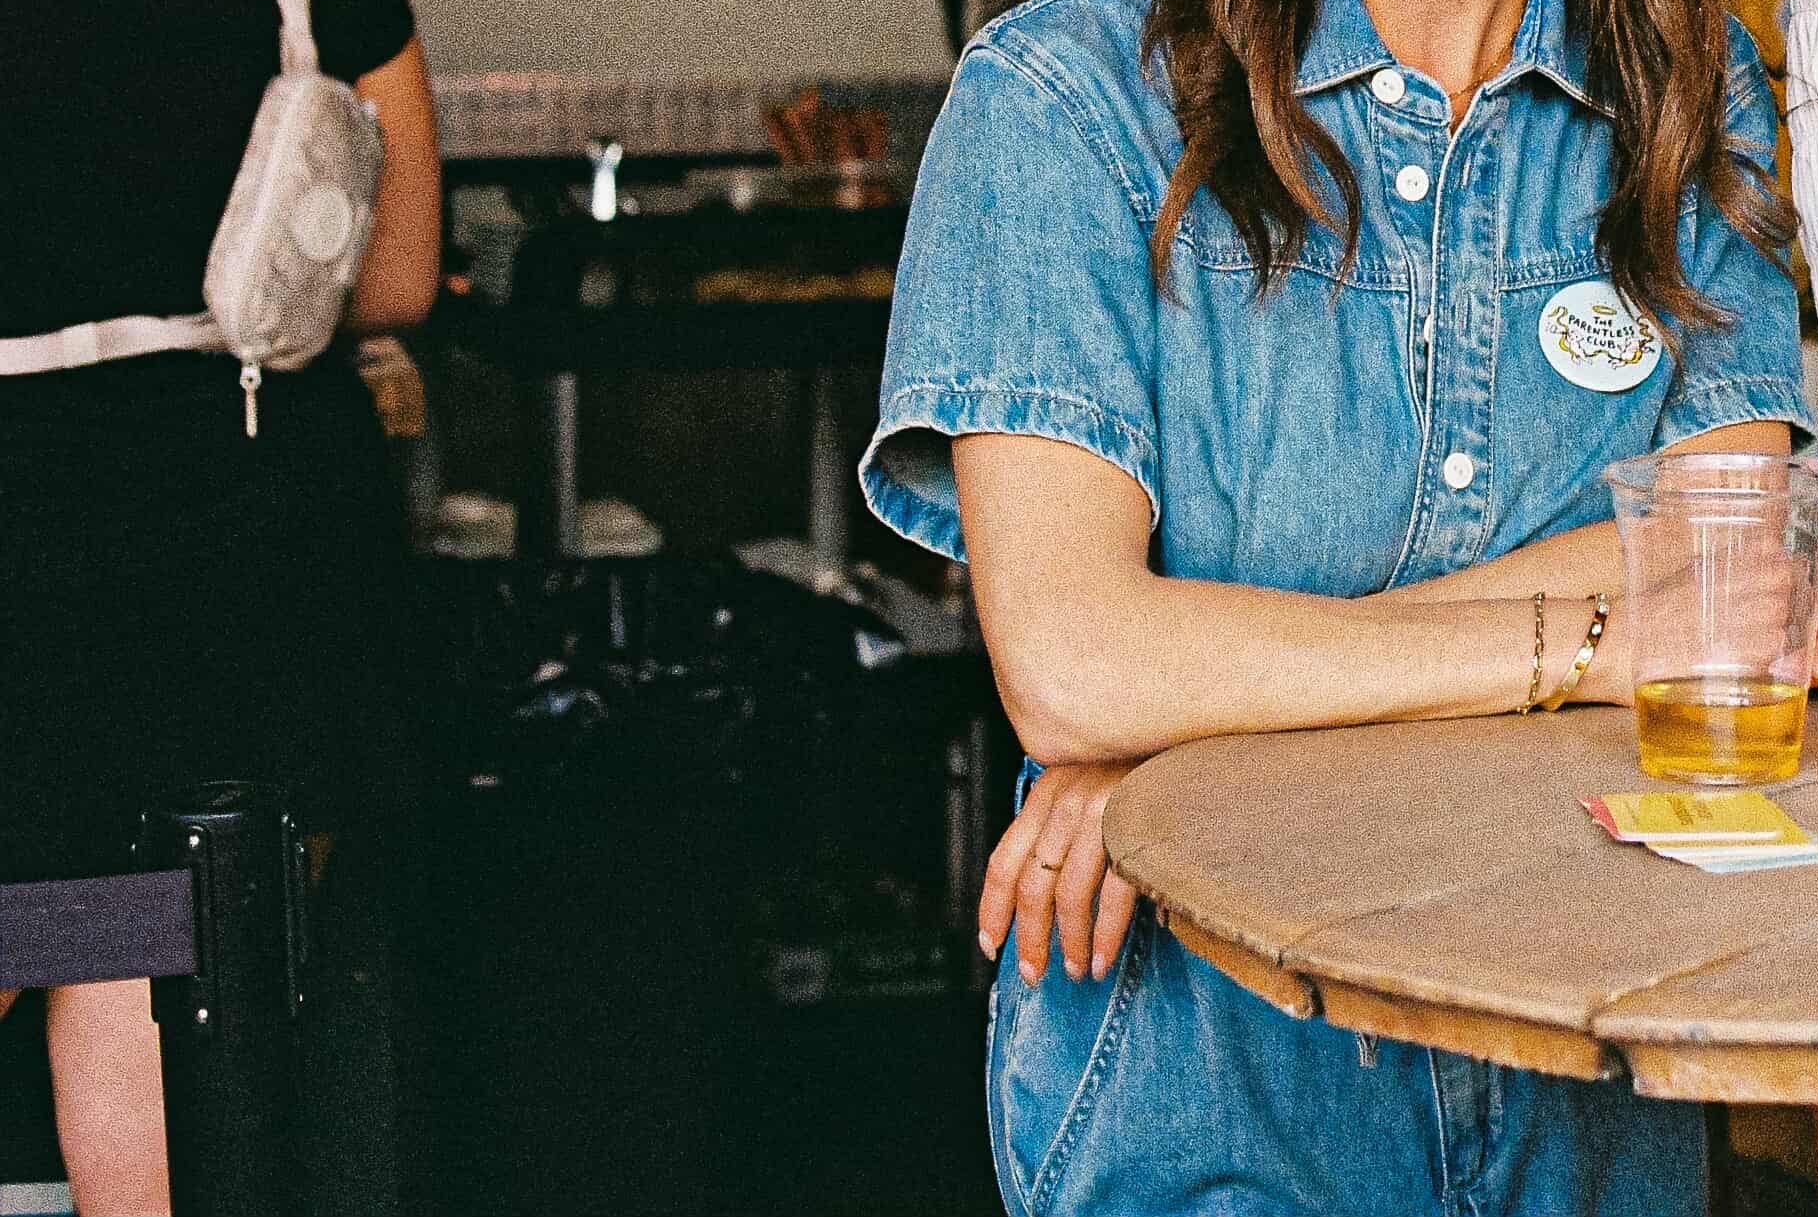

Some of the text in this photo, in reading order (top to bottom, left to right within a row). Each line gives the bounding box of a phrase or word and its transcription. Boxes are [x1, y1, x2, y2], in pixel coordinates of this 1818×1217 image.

[1568, 314, 1635, 337] PARENTLESS
[1593, 316, 1612, 327] THE
[1586, 335, 1616, 349] CLUB
